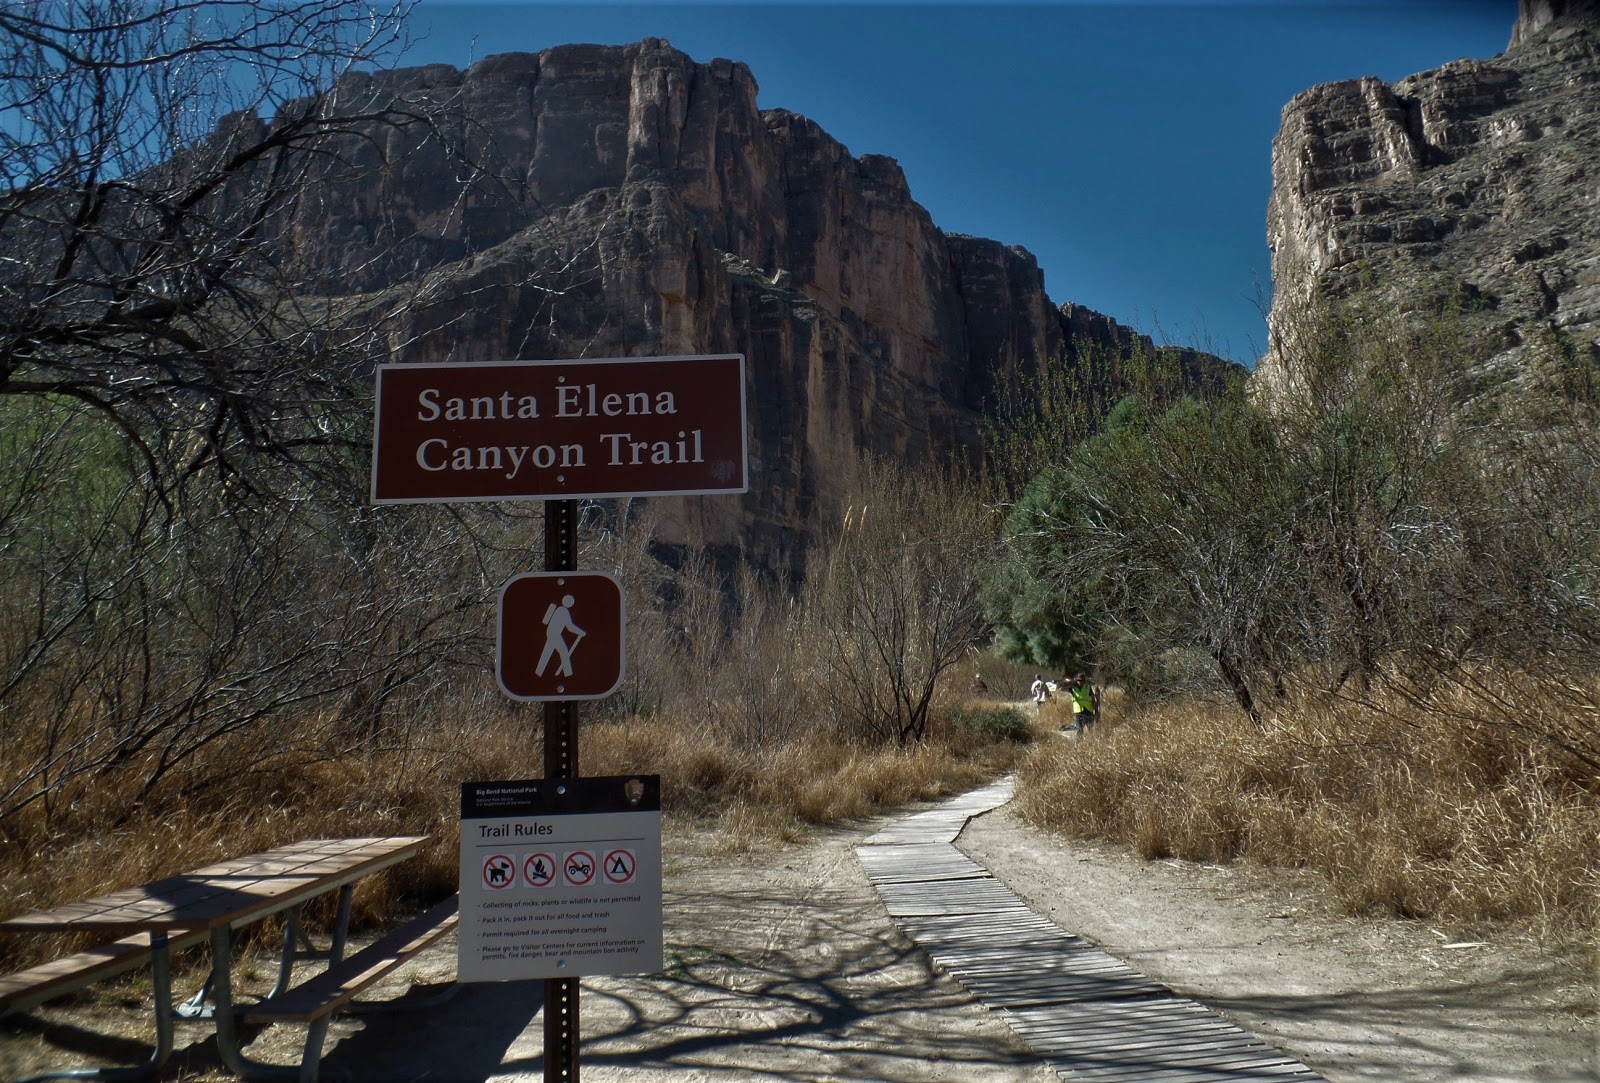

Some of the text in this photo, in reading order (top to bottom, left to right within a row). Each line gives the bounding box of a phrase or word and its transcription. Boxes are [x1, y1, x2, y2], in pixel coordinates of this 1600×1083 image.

[418, 384, 677, 421] Santa Elena
[416, 430, 704, 480] Canyon Trail
[479, 822, 552, 837] Trail Rules
